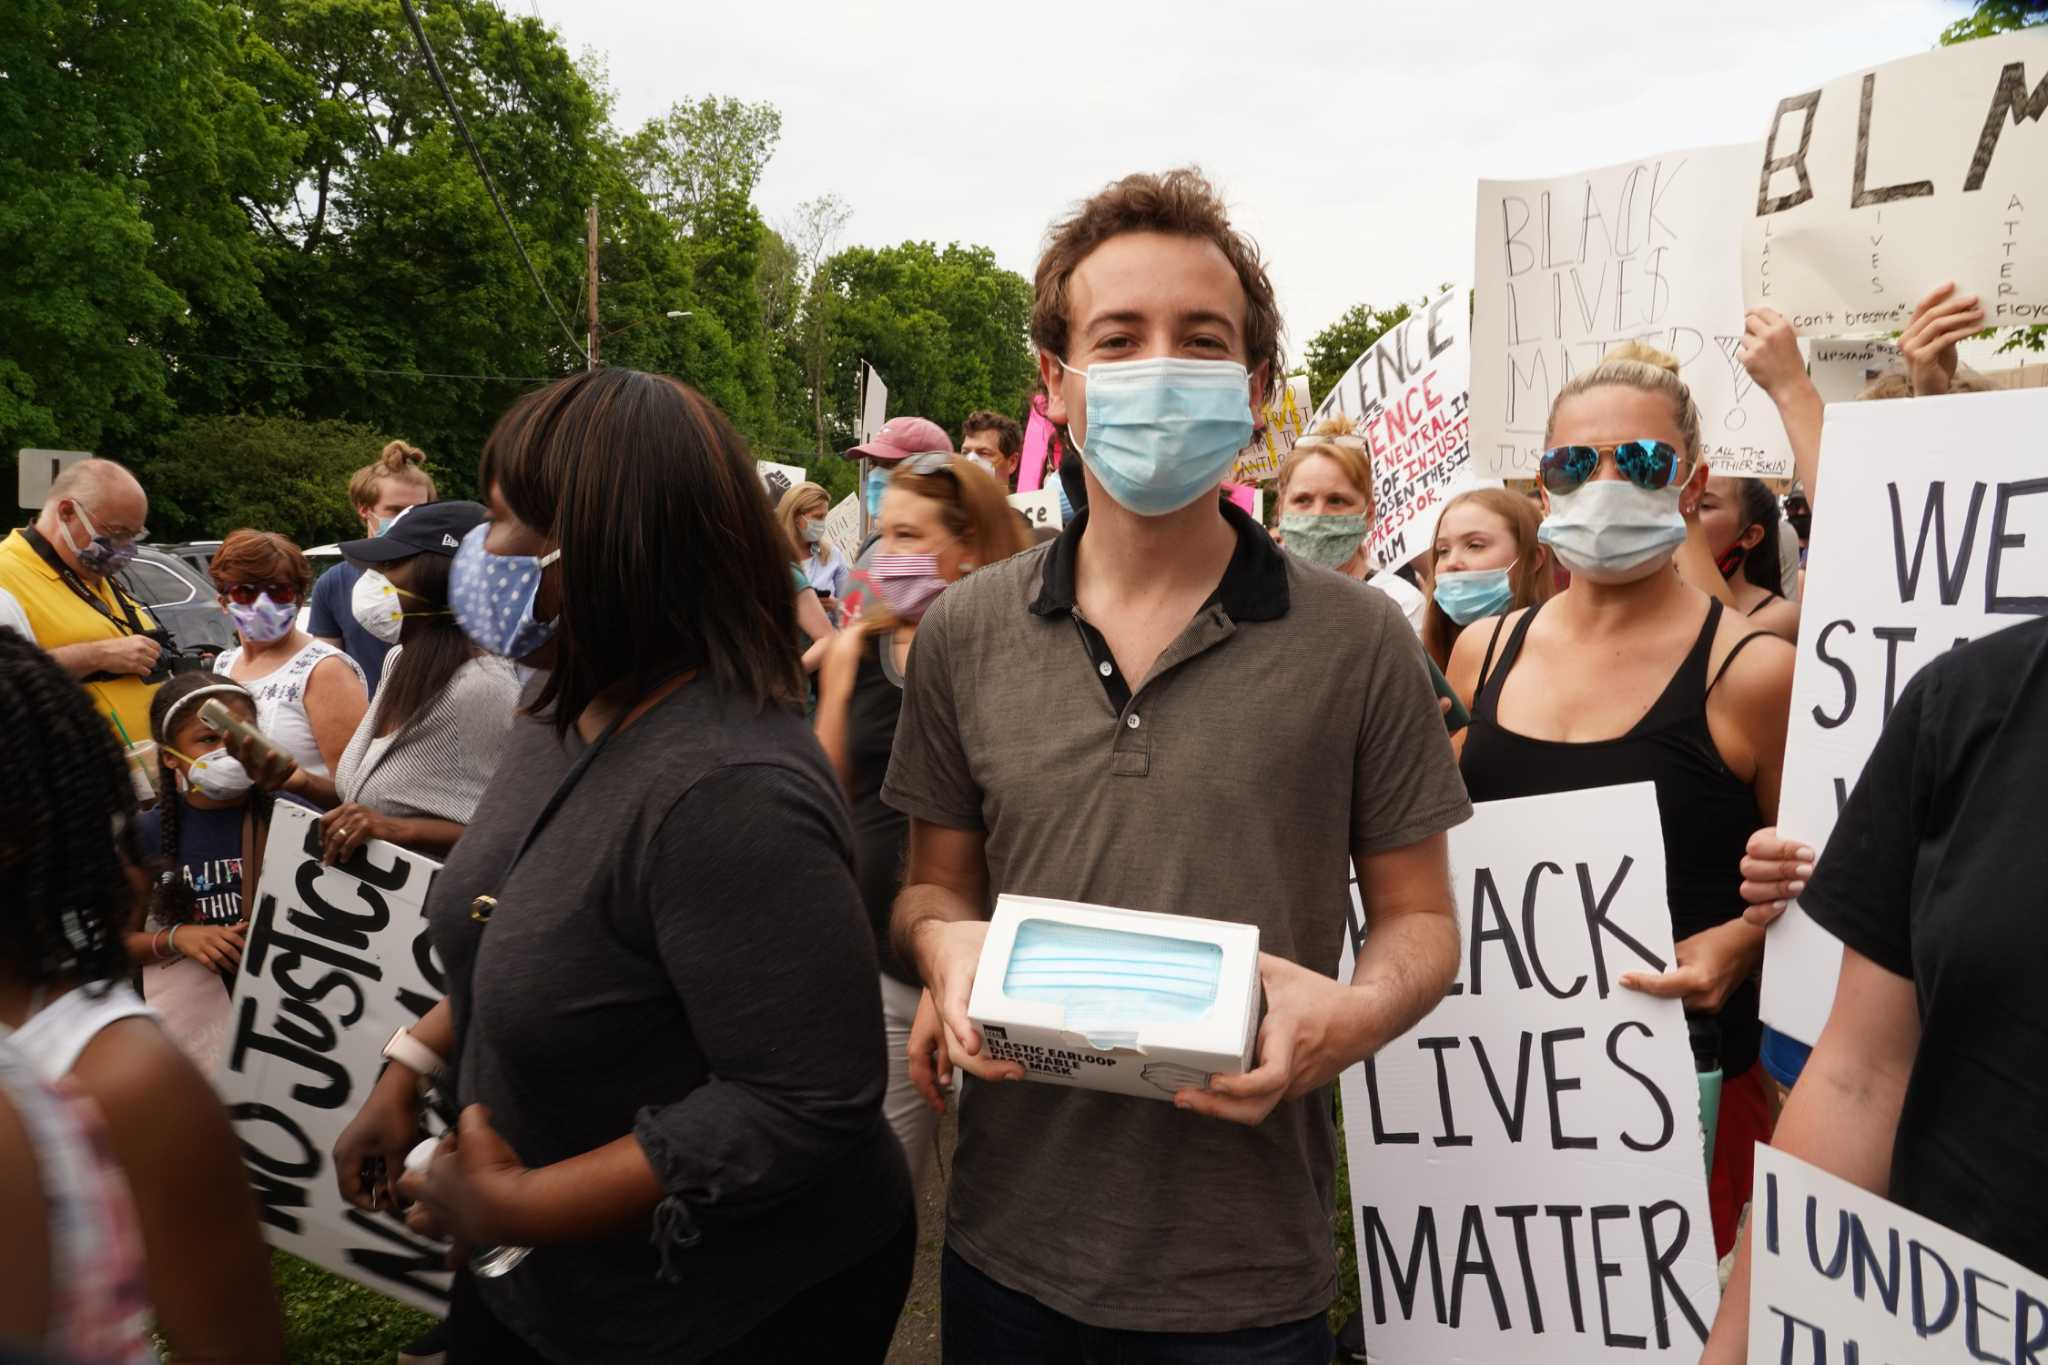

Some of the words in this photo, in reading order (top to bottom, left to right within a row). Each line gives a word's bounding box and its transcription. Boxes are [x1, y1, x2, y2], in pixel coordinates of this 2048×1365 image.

[1502, 158, 1688, 278] BLACK
[1506, 246, 1670, 347] LIVES
[1384, 409, 1452, 471] NEUTRAL
[1382, 470, 1401, 497] OF
[1377, 531, 1407, 569] BLM
[1887, 476, 2048, 615] WE
[986, 1038, 1046, 1056] ELASTIC
[1047, 1048, 1117, 1067] EARLOOP
[989, 1046, 1082, 1070] DISPOSABLE
[1029, 1062, 1073, 1077] MASK
[1364, 1021, 1675, 1152] LIVES
[1362, 1200, 1709, 1350] MATTER
[1765, 1172, 1780, 1256] I
[1804, 1194, 2048, 1365] UNDER
